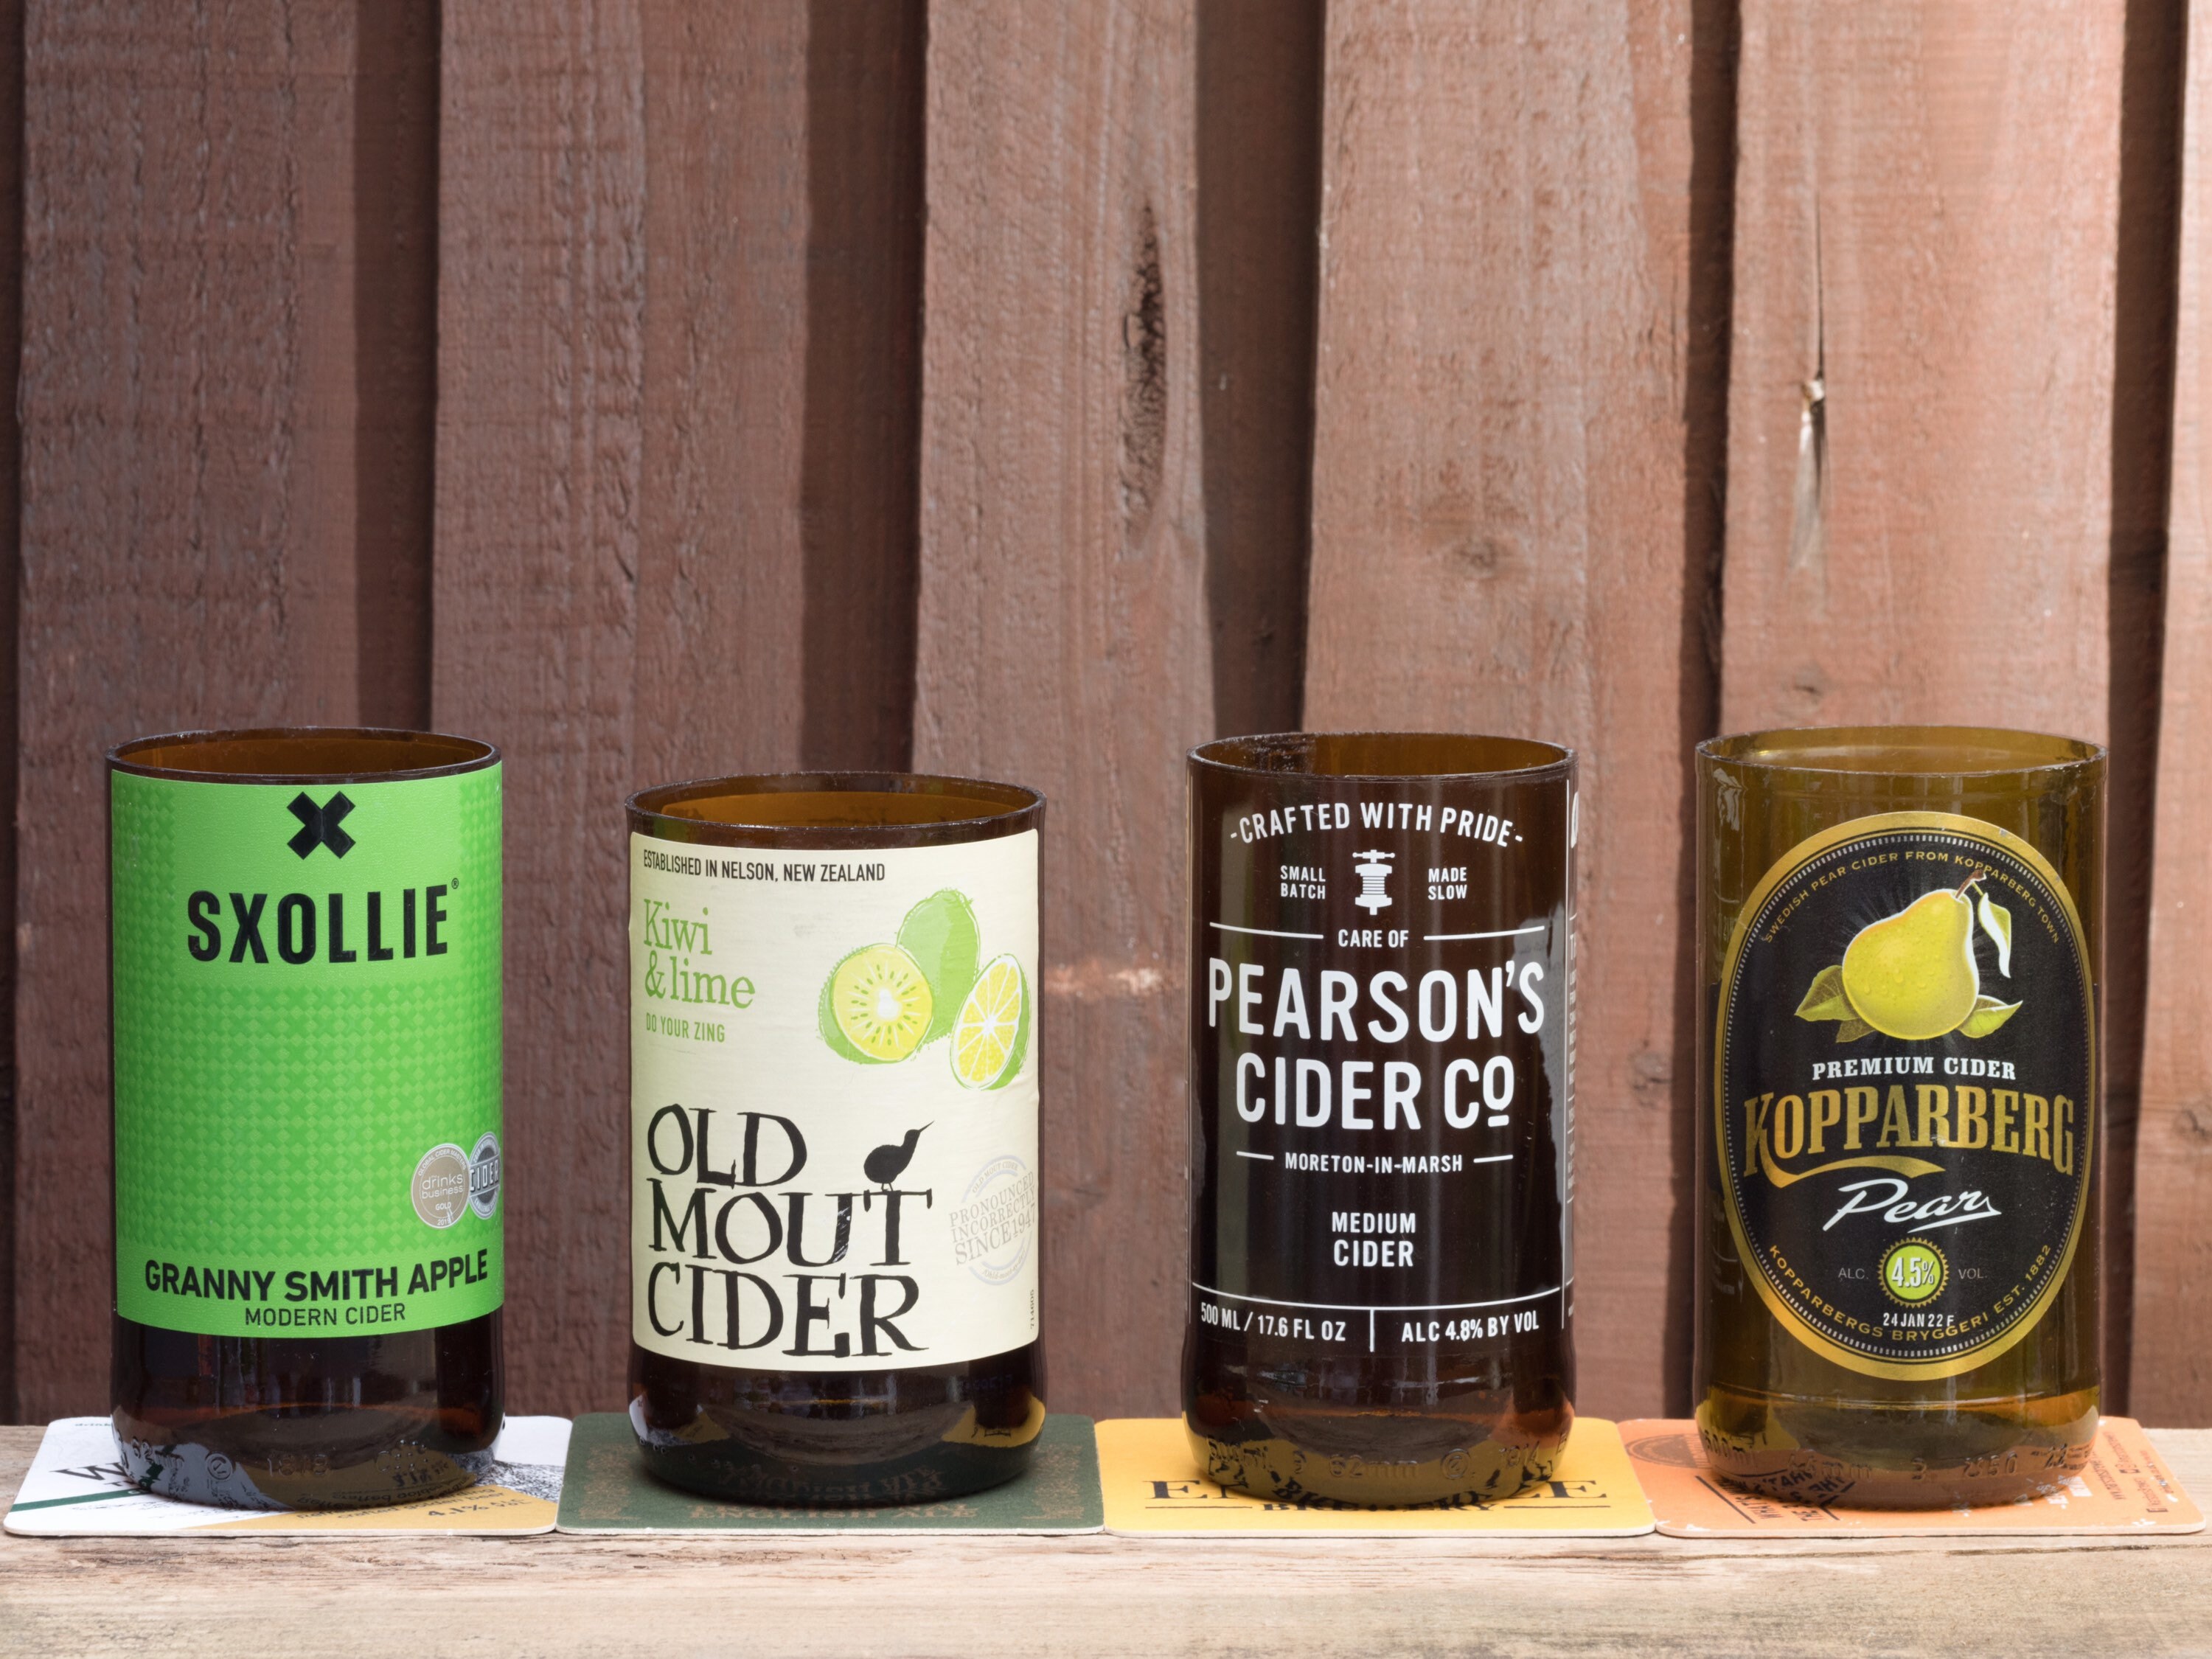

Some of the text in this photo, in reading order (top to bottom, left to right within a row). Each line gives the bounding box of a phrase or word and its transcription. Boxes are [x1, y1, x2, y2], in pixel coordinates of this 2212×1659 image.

[1360, 802, 1432, 832] WITH
[643, 849, 886, 883] ESTABLISHED IN NELSON, NEW ZEALAND
[1280, 865, 1326, 883] SMALL
[1428, 867, 1467, 883] MADE
[1280, 883, 1326, 900] BATCH
[1427, 885, 1467, 900] SLOW
[1764, 851, 2060, 945] SWEDISH PEAR CIDER FROM KOPPARBERG TOWN
[644, 898, 713, 956] Kiwi
[1338, 929, 1409, 948] CARE OF
[646, 1012, 726, 1043] DO YOUR ZING
[1812, 1057, 2017, 1081] PREMIUM CIDER
[1236, 1052, 1422, 1130] CIDER
[647, 1103, 808, 1189] OLD
[1743, 1084, 2074, 1180] KOPPARBERG
[470, 1159, 499, 1192] CIDER
[984, 1162, 1001, 1178] MOUT
[1002, 1161, 1019, 1171] CIDER
[1285, 1152, 1463, 1173] MORETON-IN-MARSH
[422, 1173, 464, 1191] drinks
[422, 1186, 465, 1200] business
[435, 1202, 452, 1211] GOLD
[949, 1171, 1034, 1227] PRONOUNCED
[950, 1185, 1035, 1243] INCORRECTLY
[1822, 1178, 2002, 1234] Pear
[646, 1177, 933, 1268] MOUT
[1332, 1212, 1416, 1234] MEDIUM
[955, 1221, 1012, 1265] SINCE
[1333, 1239, 1414, 1267] CIDER
[145, 1248, 487, 1302] GRANNY SMITH APPLE
[1837, 1267, 1869, 1280] ALC.
[1891, 1257, 1935, 1288] 4.5%
[1958, 1267, 1988, 1279] VOL.
[1770, 1245, 2051, 1340] KOPPARBERGS BRYGGERI EST. 1882
[246, 1303, 406, 1326] MODERN CIDER
[647, 1262, 929, 1358] CIDER
[1201, 1302, 1218, 1326] 500
[1221, 1308, 1241, 1331] ML
[1257, 1315, 1289, 1337] 17.6
[1293, 1318, 1315, 1340] FL
[1321, 1320, 1346, 1341] OZ
[1882, 1312, 1898, 1326] 24
[1900, 1313, 1925, 1327] JAN
[1927, 1314, 1944, 1327] 22
[1401, 1310, 1540, 1343] ALC 4.8% BY VOL
